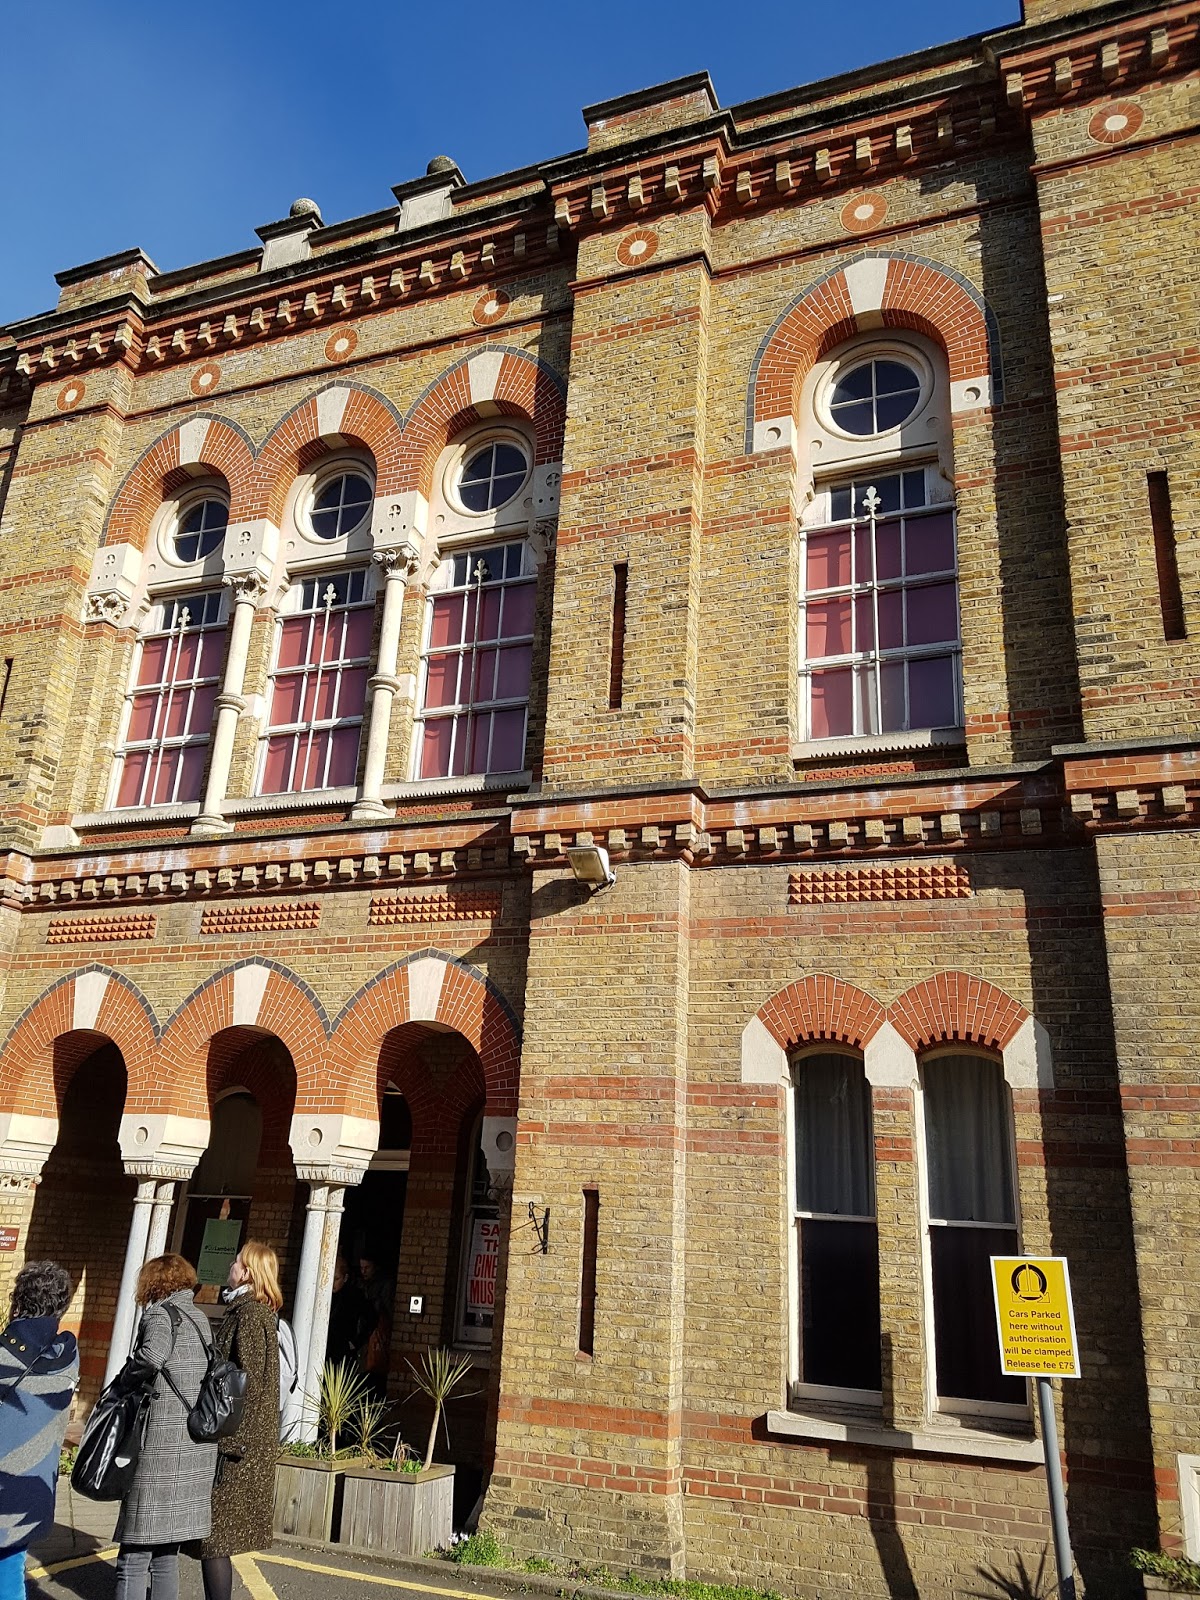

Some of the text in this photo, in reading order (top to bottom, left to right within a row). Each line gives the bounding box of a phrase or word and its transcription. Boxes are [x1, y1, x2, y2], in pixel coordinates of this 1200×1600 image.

[480, 1223, 500, 1237] SA
[484, 1239, 499, 1252] TH
[474, 1254, 498, 1279] CINE
[470, 1280, 495, 1305] MUS
[1008, 1310, 1061, 1319] Cars Parked
[1009, 1322, 1063, 1331] here without
[1009, 1335, 1067, 1344] authorisation
[1004, 1346, 1074, 1358] will be clamped.
[1006, 1359, 1075, 1370] Release fee £75
